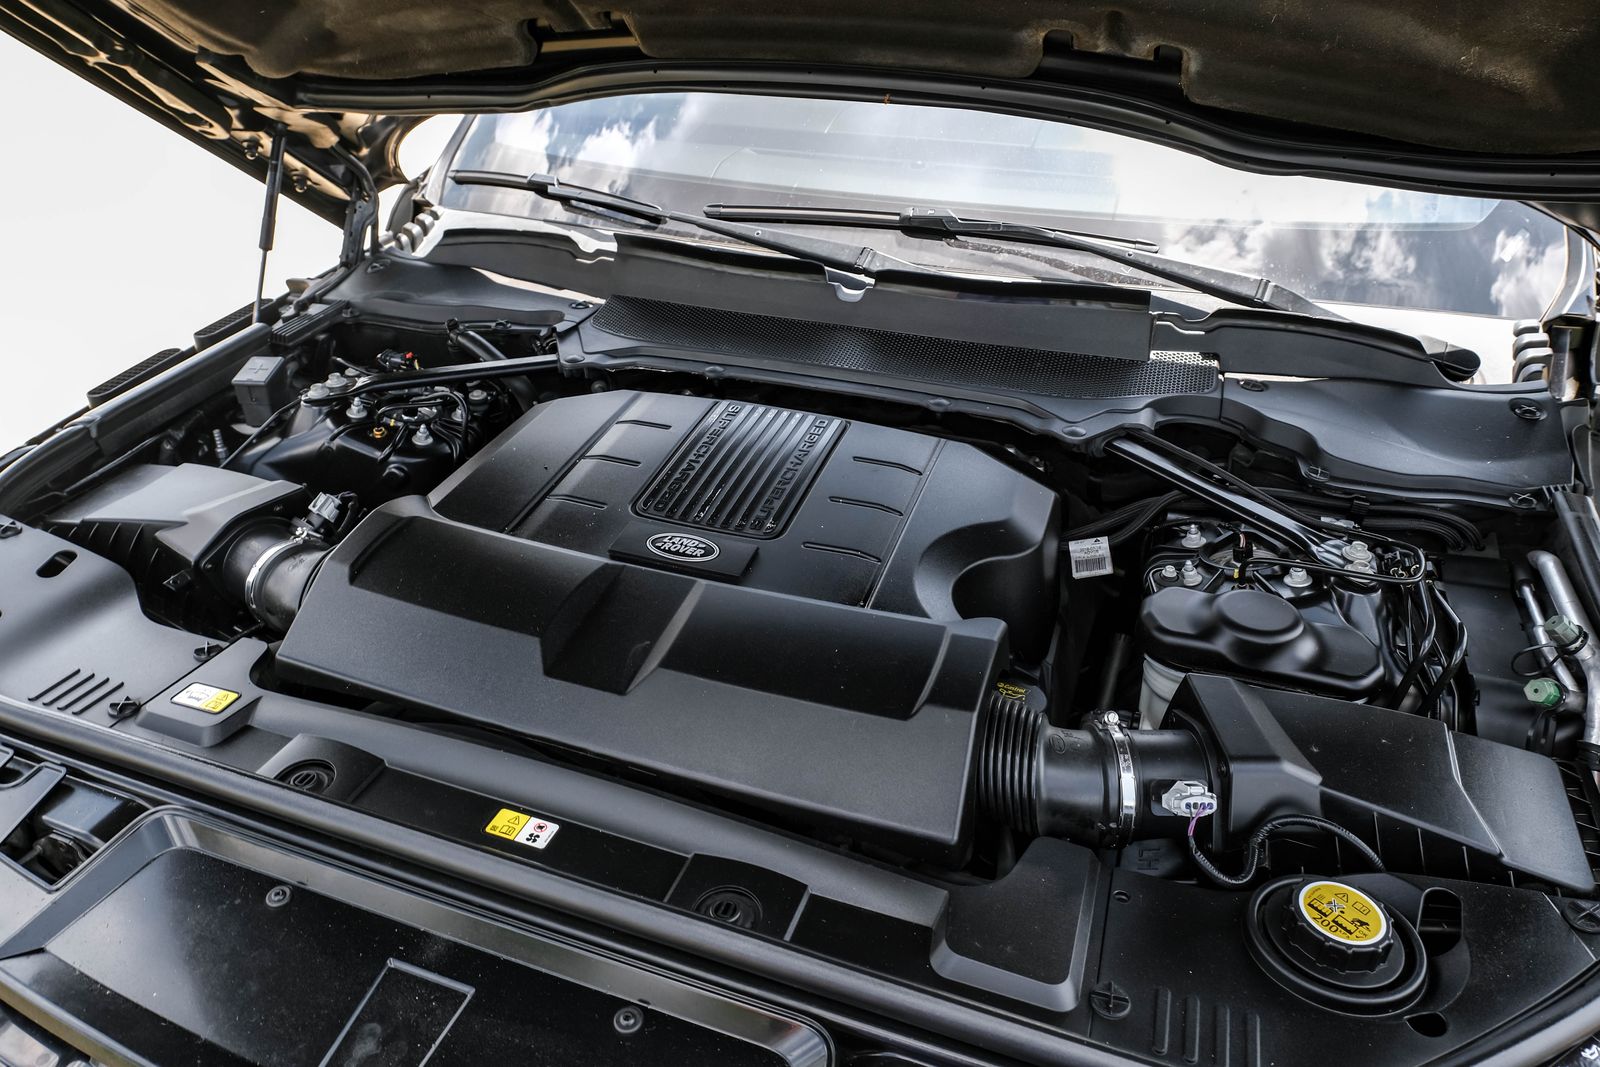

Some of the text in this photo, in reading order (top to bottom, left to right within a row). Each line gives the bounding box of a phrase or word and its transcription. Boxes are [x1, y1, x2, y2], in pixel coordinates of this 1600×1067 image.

[653, 403, 741, 512] SUPERCHARGED
[750, 418, 829, 531] SUPERCHARGED
[660, 542, 706, 557] ROVER
[662, 535, 699, 548] LAND
[1311, 913, 1339, 933] 200
